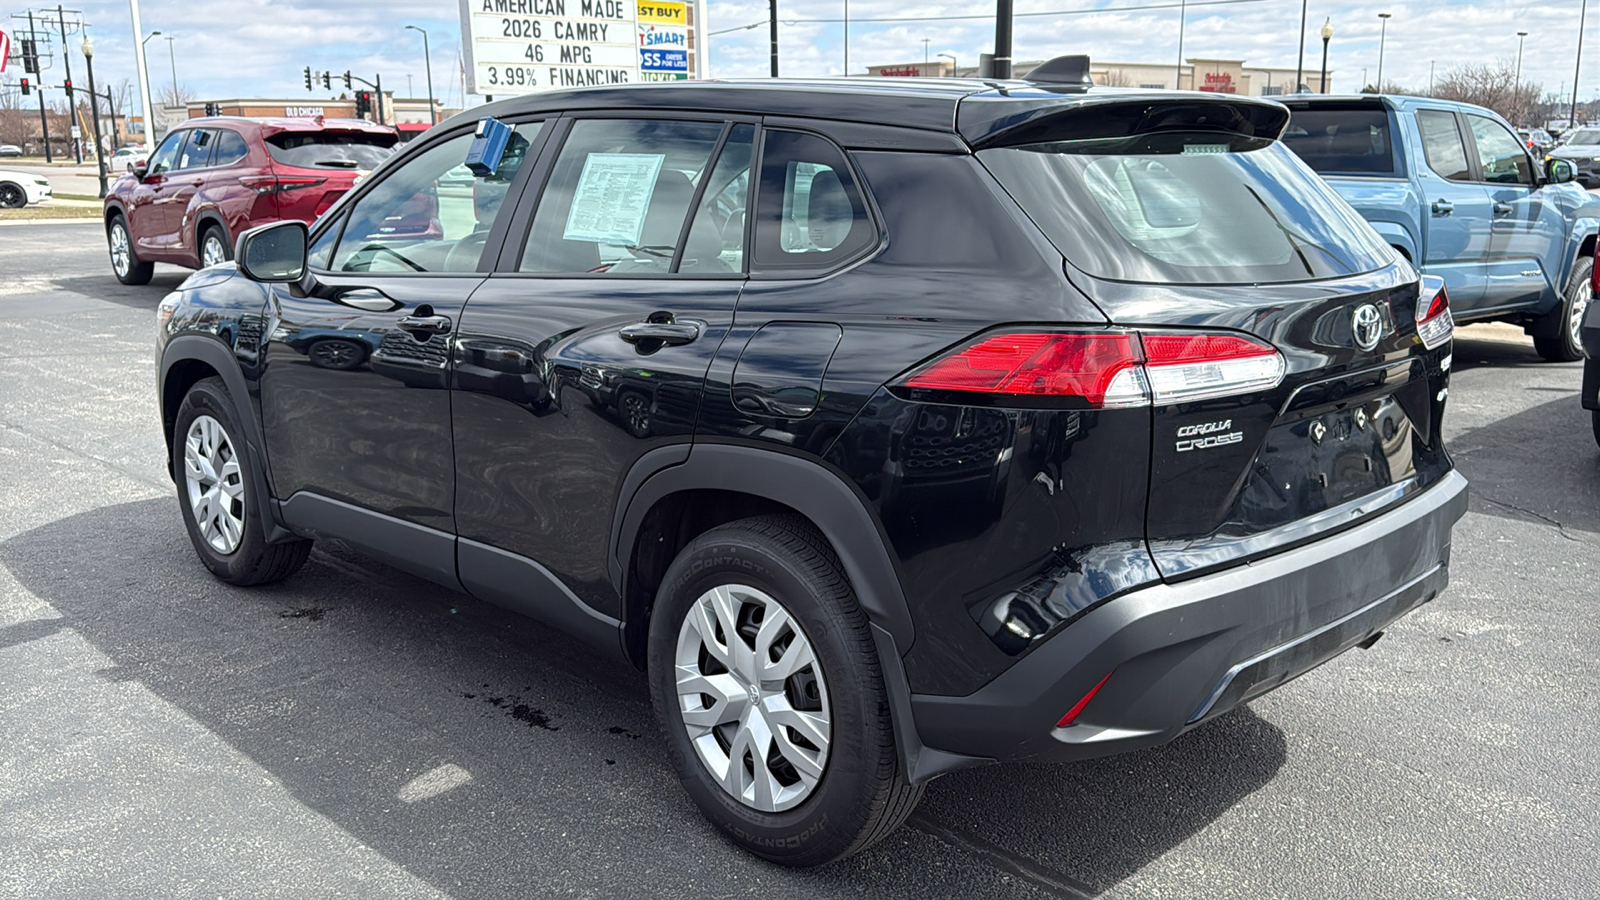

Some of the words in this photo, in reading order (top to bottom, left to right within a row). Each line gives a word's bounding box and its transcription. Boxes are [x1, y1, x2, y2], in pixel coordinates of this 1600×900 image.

[483, 0, 565, 16] AMERICAN
[581, 0, 624, 19] MADE
[657, 8, 682, 18] BUY
[502, 18, 542, 39] 2026
[554, 21, 609, 41] CAMRY
[525, 43, 544, 62] 46
[560, 45, 592, 63] MPG
[674, 60, 687, 68] LESS
[488, 67, 537, 87] 3.99%
[549, 68, 629, 87] FINANCING
[286, 107, 298, 117] OLD
[299, 107, 324, 117] CHICAGO
[1177, 419, 1232, 437] COROLLA
[1176, 431, 1243, 452] CROSS
